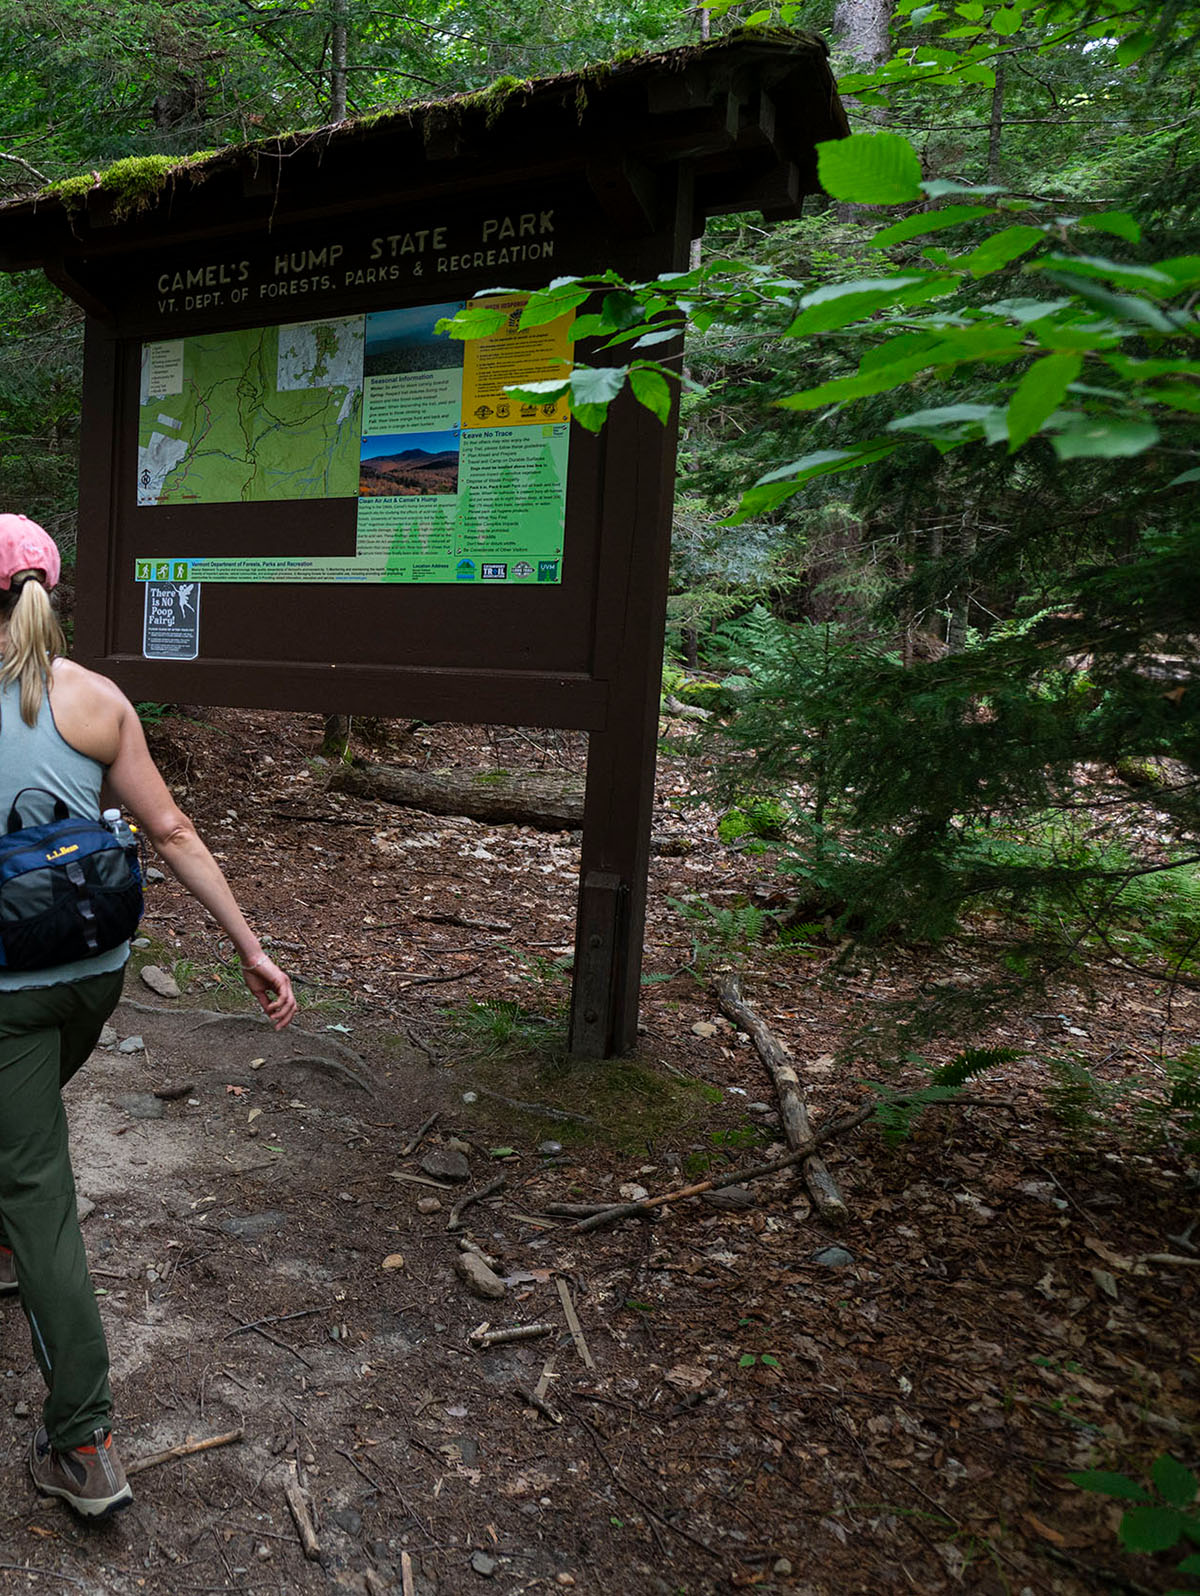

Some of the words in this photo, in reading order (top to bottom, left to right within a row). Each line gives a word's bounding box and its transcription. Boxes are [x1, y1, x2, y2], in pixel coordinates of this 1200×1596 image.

[158, 261, 250, 293] CAMEL'S
[274, 245, 343, 275] HUMP
[370, 227, 448, 259] STATE
[482, 210, 554, 242] PARK
[158, 300, 178, 313] VT.
[185, 292, 224, 310] DEPT.
[231, 288, 248, 303] OF
[346, 266, 399, 286] PARKS
[413, 261, 423, 276] &
[437, 241, 554, 273] RECREATION
[371, 376, 398, 384] Seasonal
[399, 374, 434, 382] Information
[150, 588, 176, 598] There
[161, 598, 173, 606] NO
[152, 606, 173, 617] Poop
[149, 616, 175, 627] Fairy!
